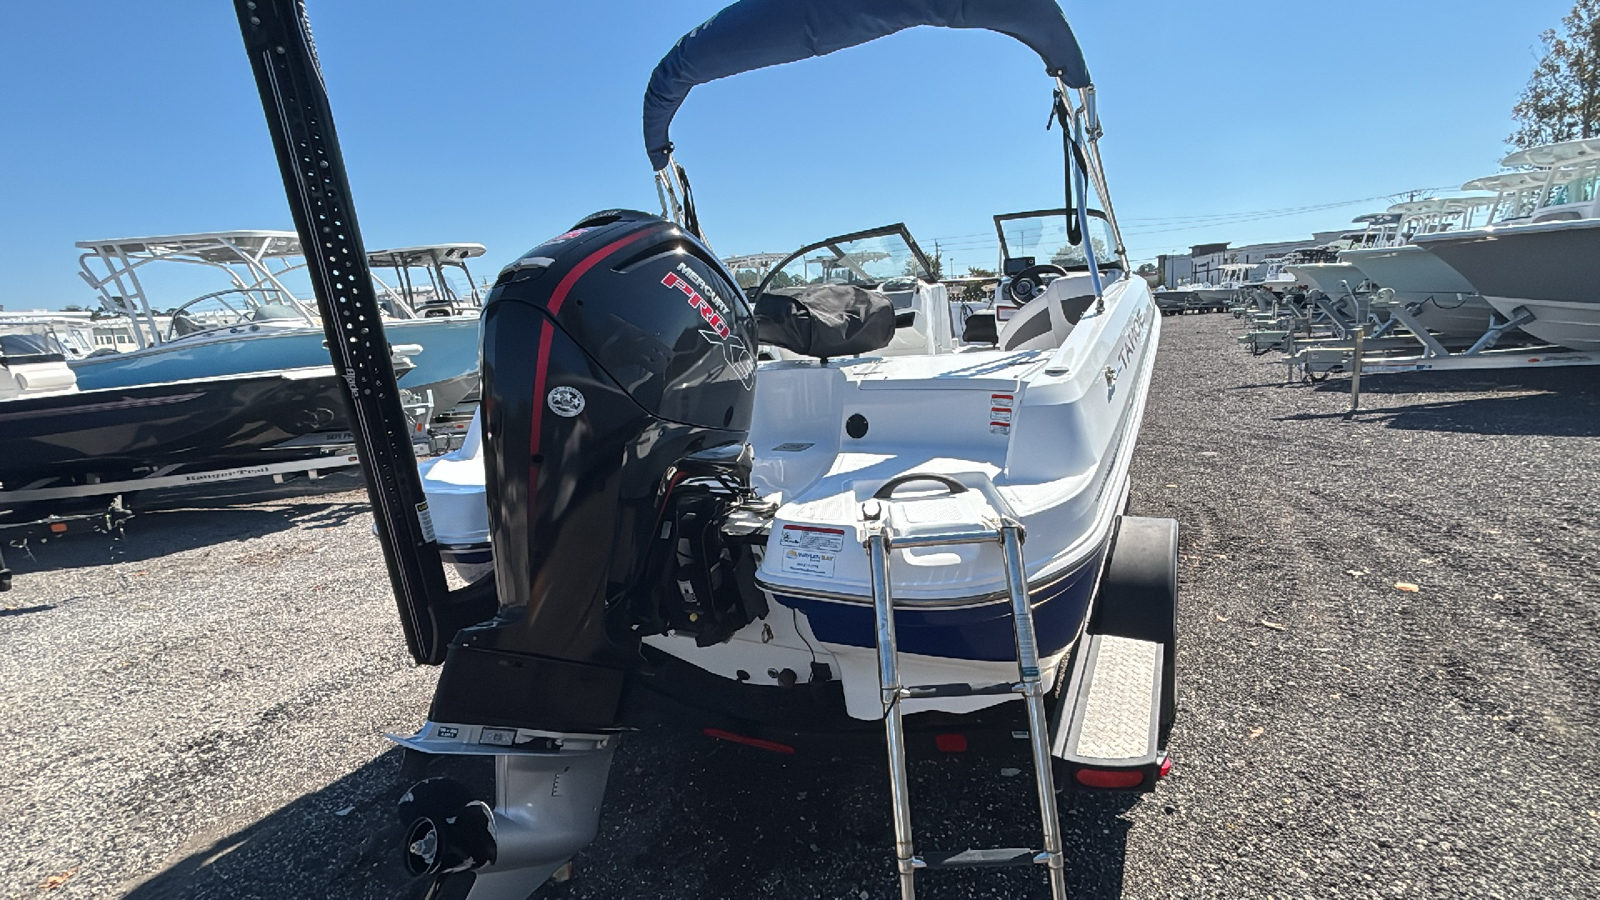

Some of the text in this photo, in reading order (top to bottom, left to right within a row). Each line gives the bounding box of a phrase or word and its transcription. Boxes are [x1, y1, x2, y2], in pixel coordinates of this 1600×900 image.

[661, 271, 730, 340] PRO
[676, 262, 730, 314] MERCURY
[1118, 308, 1145, 369] TAHOE
[342, 367, 359, 399] Blade
